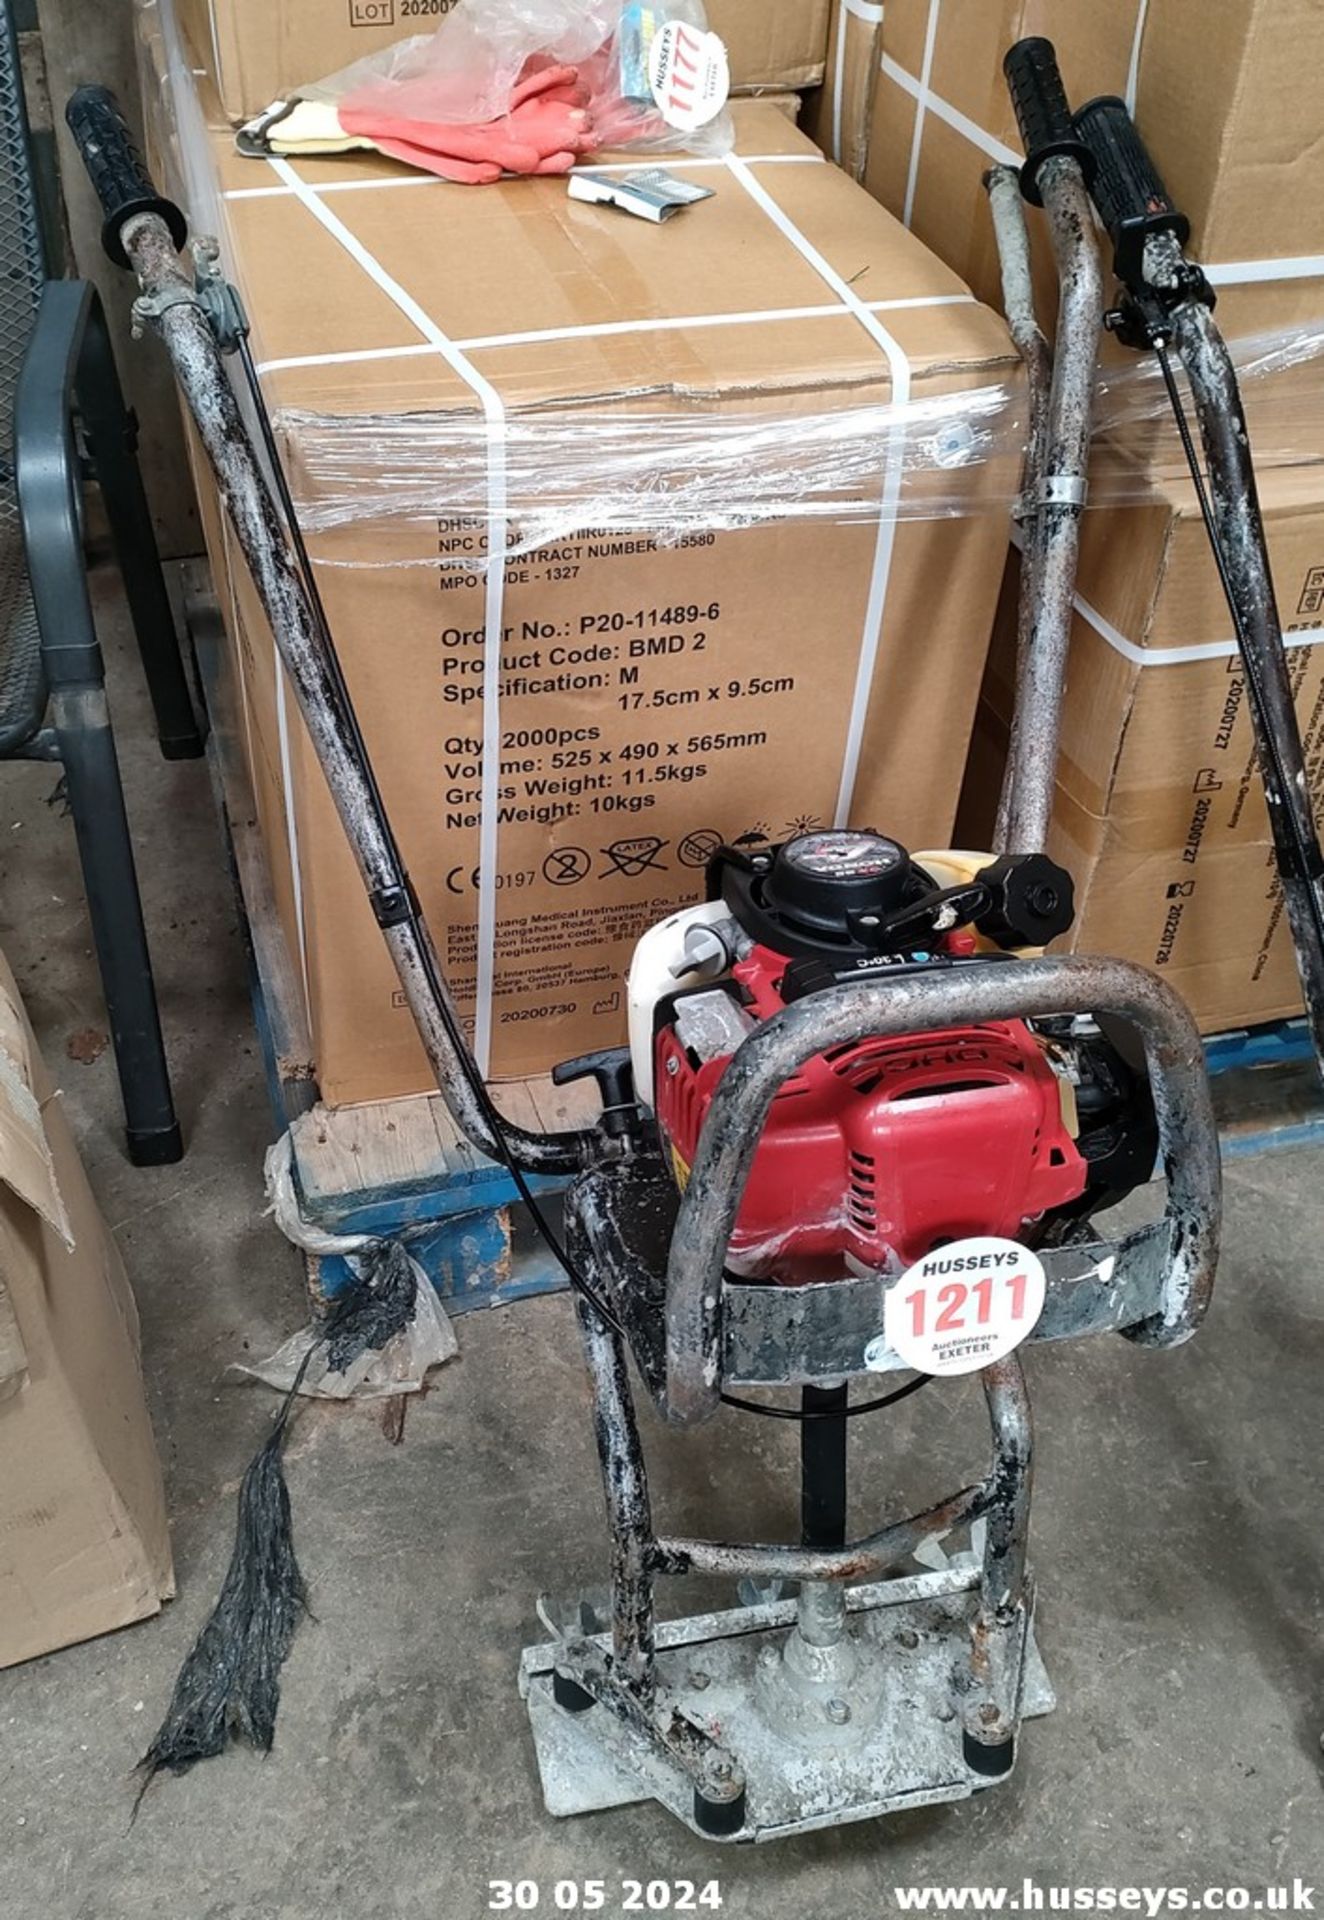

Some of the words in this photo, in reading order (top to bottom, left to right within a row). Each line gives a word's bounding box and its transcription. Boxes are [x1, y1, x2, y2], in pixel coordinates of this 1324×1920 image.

[355, 4, 389, 19] LOT
[655, 27, 673, 91] HUSSEYS
[668, 26, 701, 112] 1177
[438, 538, 474, 553] NPC
[504, 546, 583, 566] ONTRACT
[587, 539, 658, 559] NUMBER
[440, 575, 478, 591] MPO
[545, 566, 581, 582] 1327
[441, 625, 514, 648] Ordr
[522, 621, 571, 640] No.:
[579, 602, 721, 635] P20-11489-6
[442, 650, 542, 676] Prouct
[549, 643, 620, 666] Code:
[629, 634, 685, 658] BMD
[692, 632, 706, 650] 2
[619, 666, 639, 685] M
[617, 689, 700, 711] 17.5cm
[707, 687, 720, 700] x
[727, 676, 794, 698] 9.5cm
[1213, 678, 1245, 750] 20200727
[501, 726, 601, 749] 2000pcs
[444, 757, 543, 780] Volme:
[551, 749, 592, 769] 525
[599, 751, 612, 764] x
[619, 742, 660, 761] 490
[666, 743, 679, 756] x
[687, 731, 767, 753] 565mm
[525, 773, 613, 797] Weight:
[621, 764, 708, 786] 11.5kgs
[497, 801, 581, 824] Weight:
[590, 793, 656, 813] 10kgs
[1227, 786, 1250, 829] Germany
[1181, 797, 1212, 864] 20200727
[530, 909, 579, 924] Medical
[582, 900, 649, 917] Instrument
[520, 933, 564, 945] license
[1154, 903, 1184, 966] 20220726
[500, 942, 572, 958] registration
[500, 1002, 577, 1023] 20200730
[922, 1251, 1019, 1277] HUSSEYS
[904, 1274, 1028, 1338] 1211
[931, 1333, 999, 1352] Auctioneers
[938, 1342, 991, 1360] EXETER
